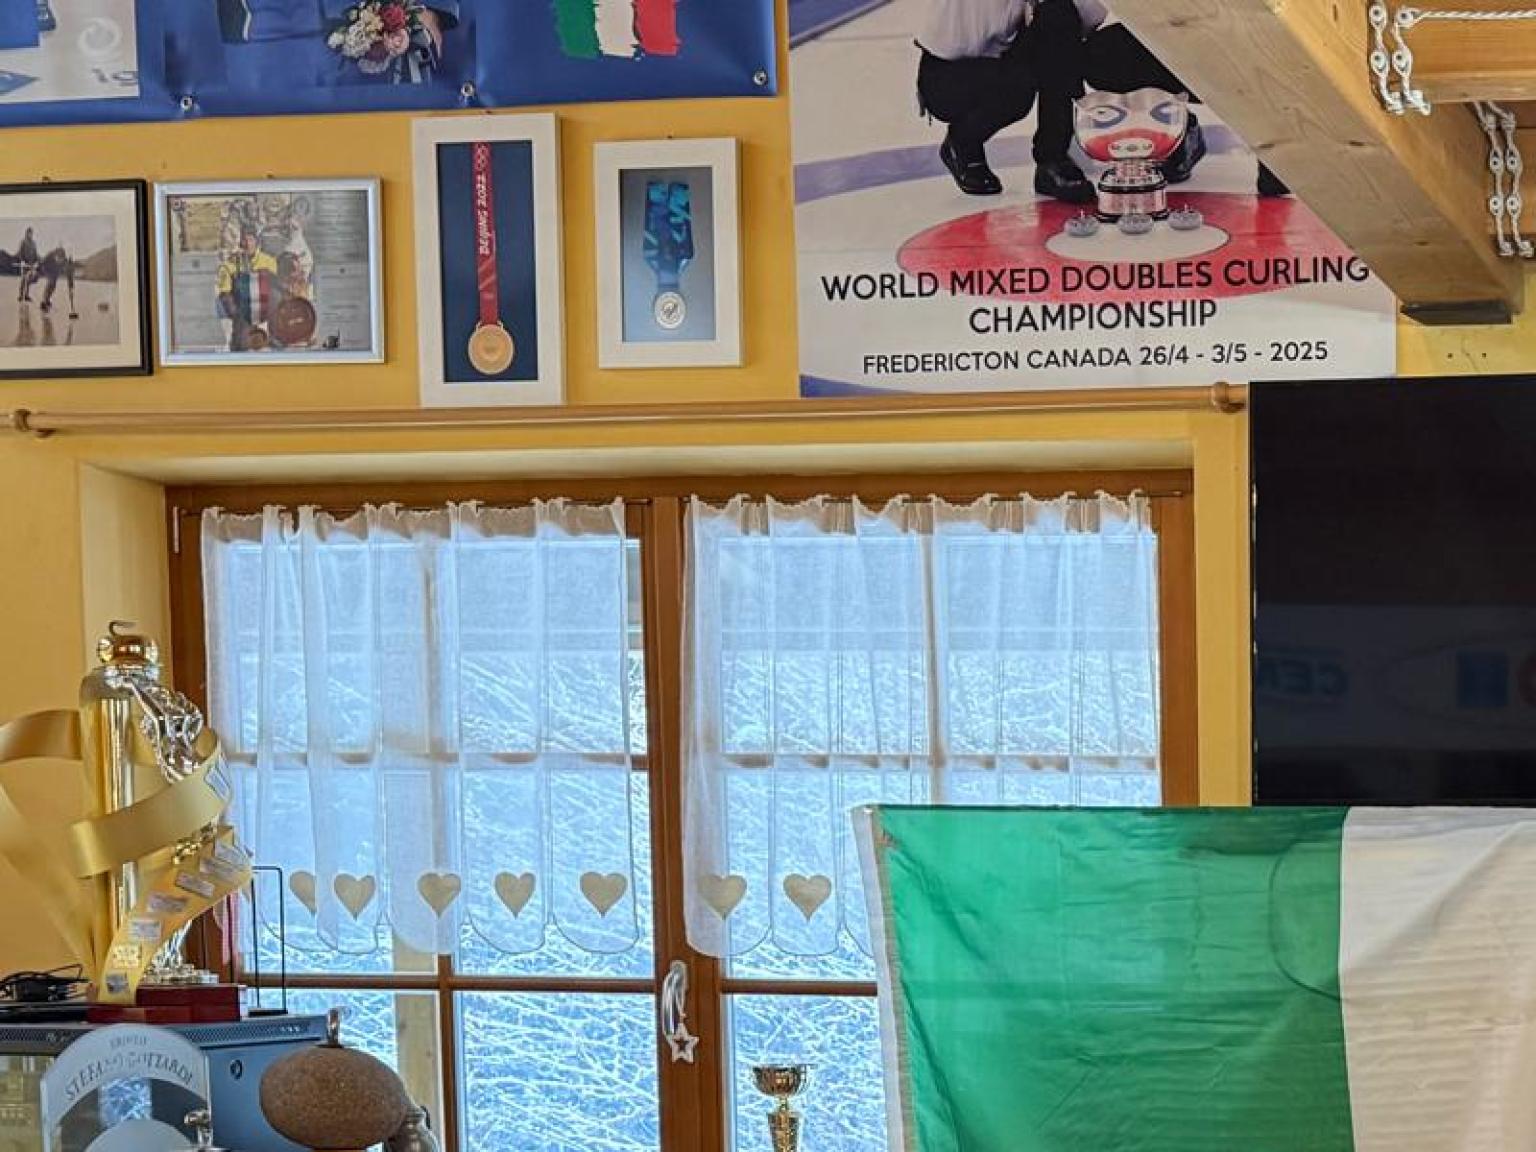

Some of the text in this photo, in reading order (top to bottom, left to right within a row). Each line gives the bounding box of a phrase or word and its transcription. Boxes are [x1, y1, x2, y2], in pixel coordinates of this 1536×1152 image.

[820, 256, 1371, 301] WORLD MIXED DOUBLES CURLING
[968, 299, 1217, 334] CHAMPIONSHIP
[862, 350, 1019, 374] FREDERICTON
[1026, 347, 1132, 369] CANADA
[1139, 345, 1189, 366] 26/4
[1212, 343, 1247, 363] 3/5
[1270, 341, 1328, 362] 2025
